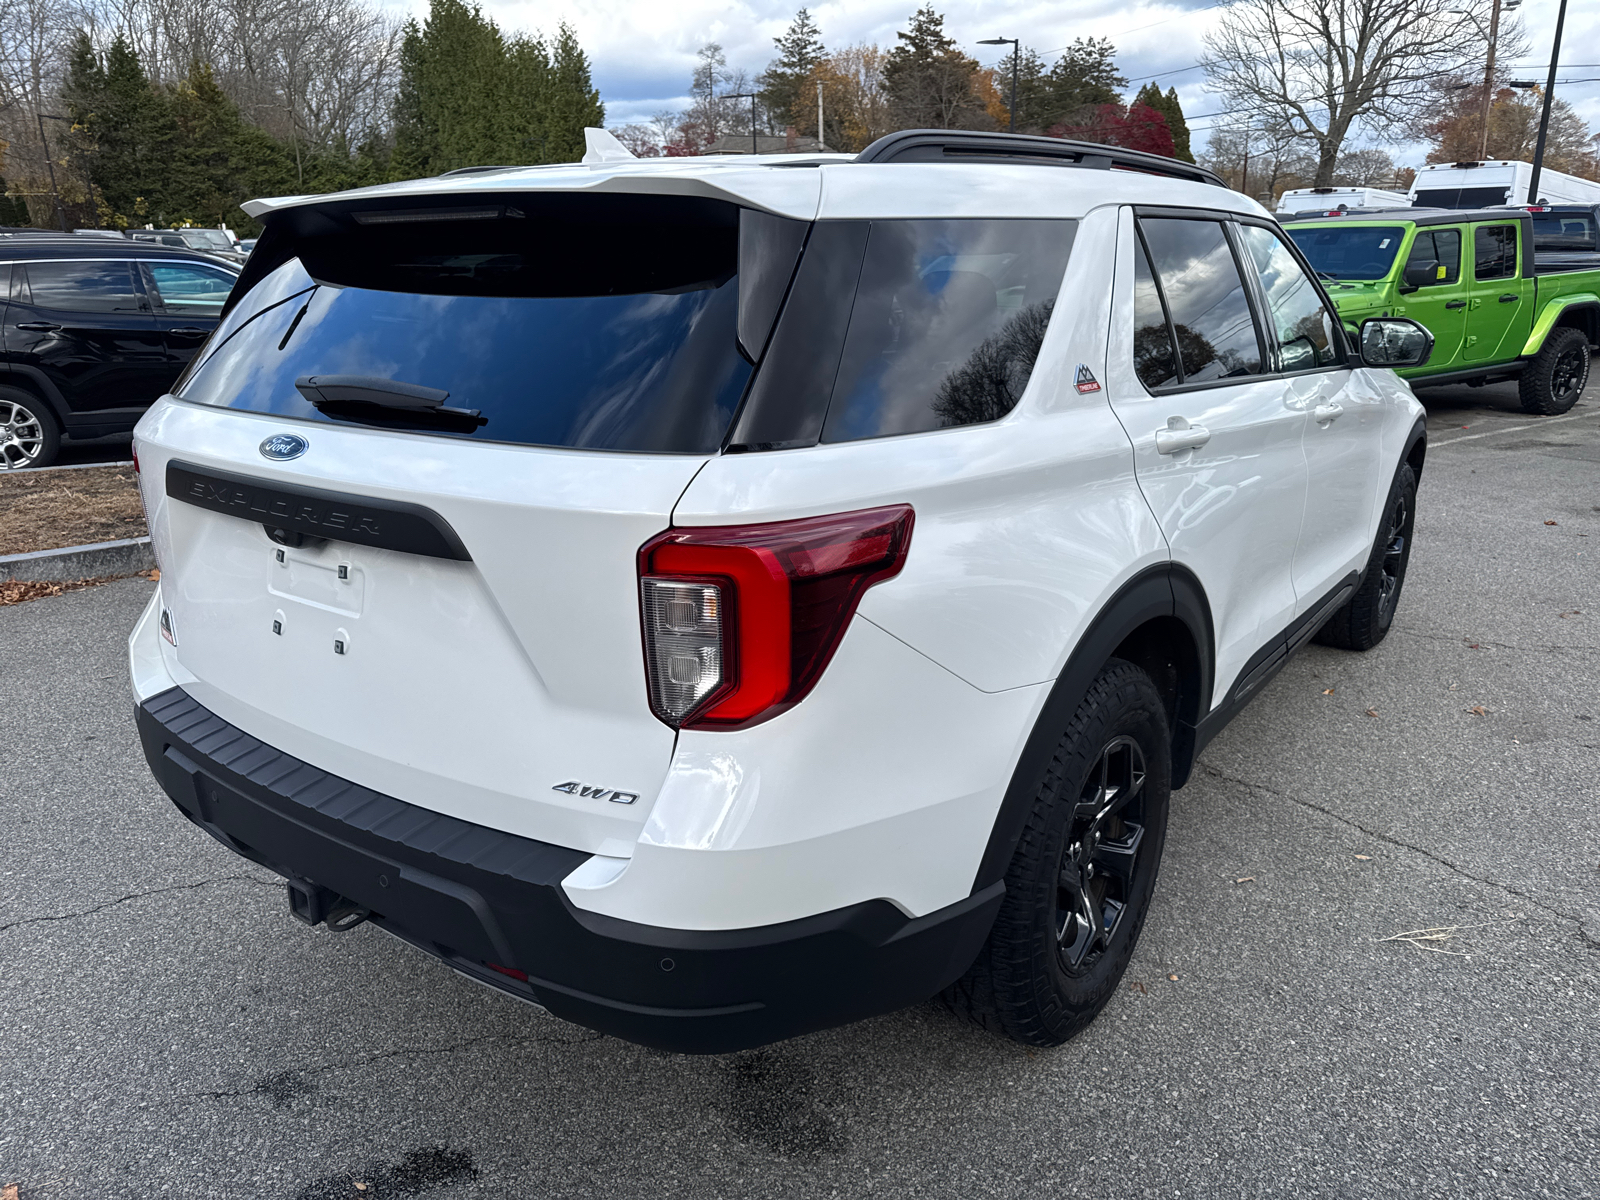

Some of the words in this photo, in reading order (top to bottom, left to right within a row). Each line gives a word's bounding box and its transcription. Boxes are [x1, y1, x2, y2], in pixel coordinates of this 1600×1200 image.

[265, 436, 296, 454] Ford
[187, 481, 380, 535] EXPLORER
[552, 780, 640, 805] 4WD
